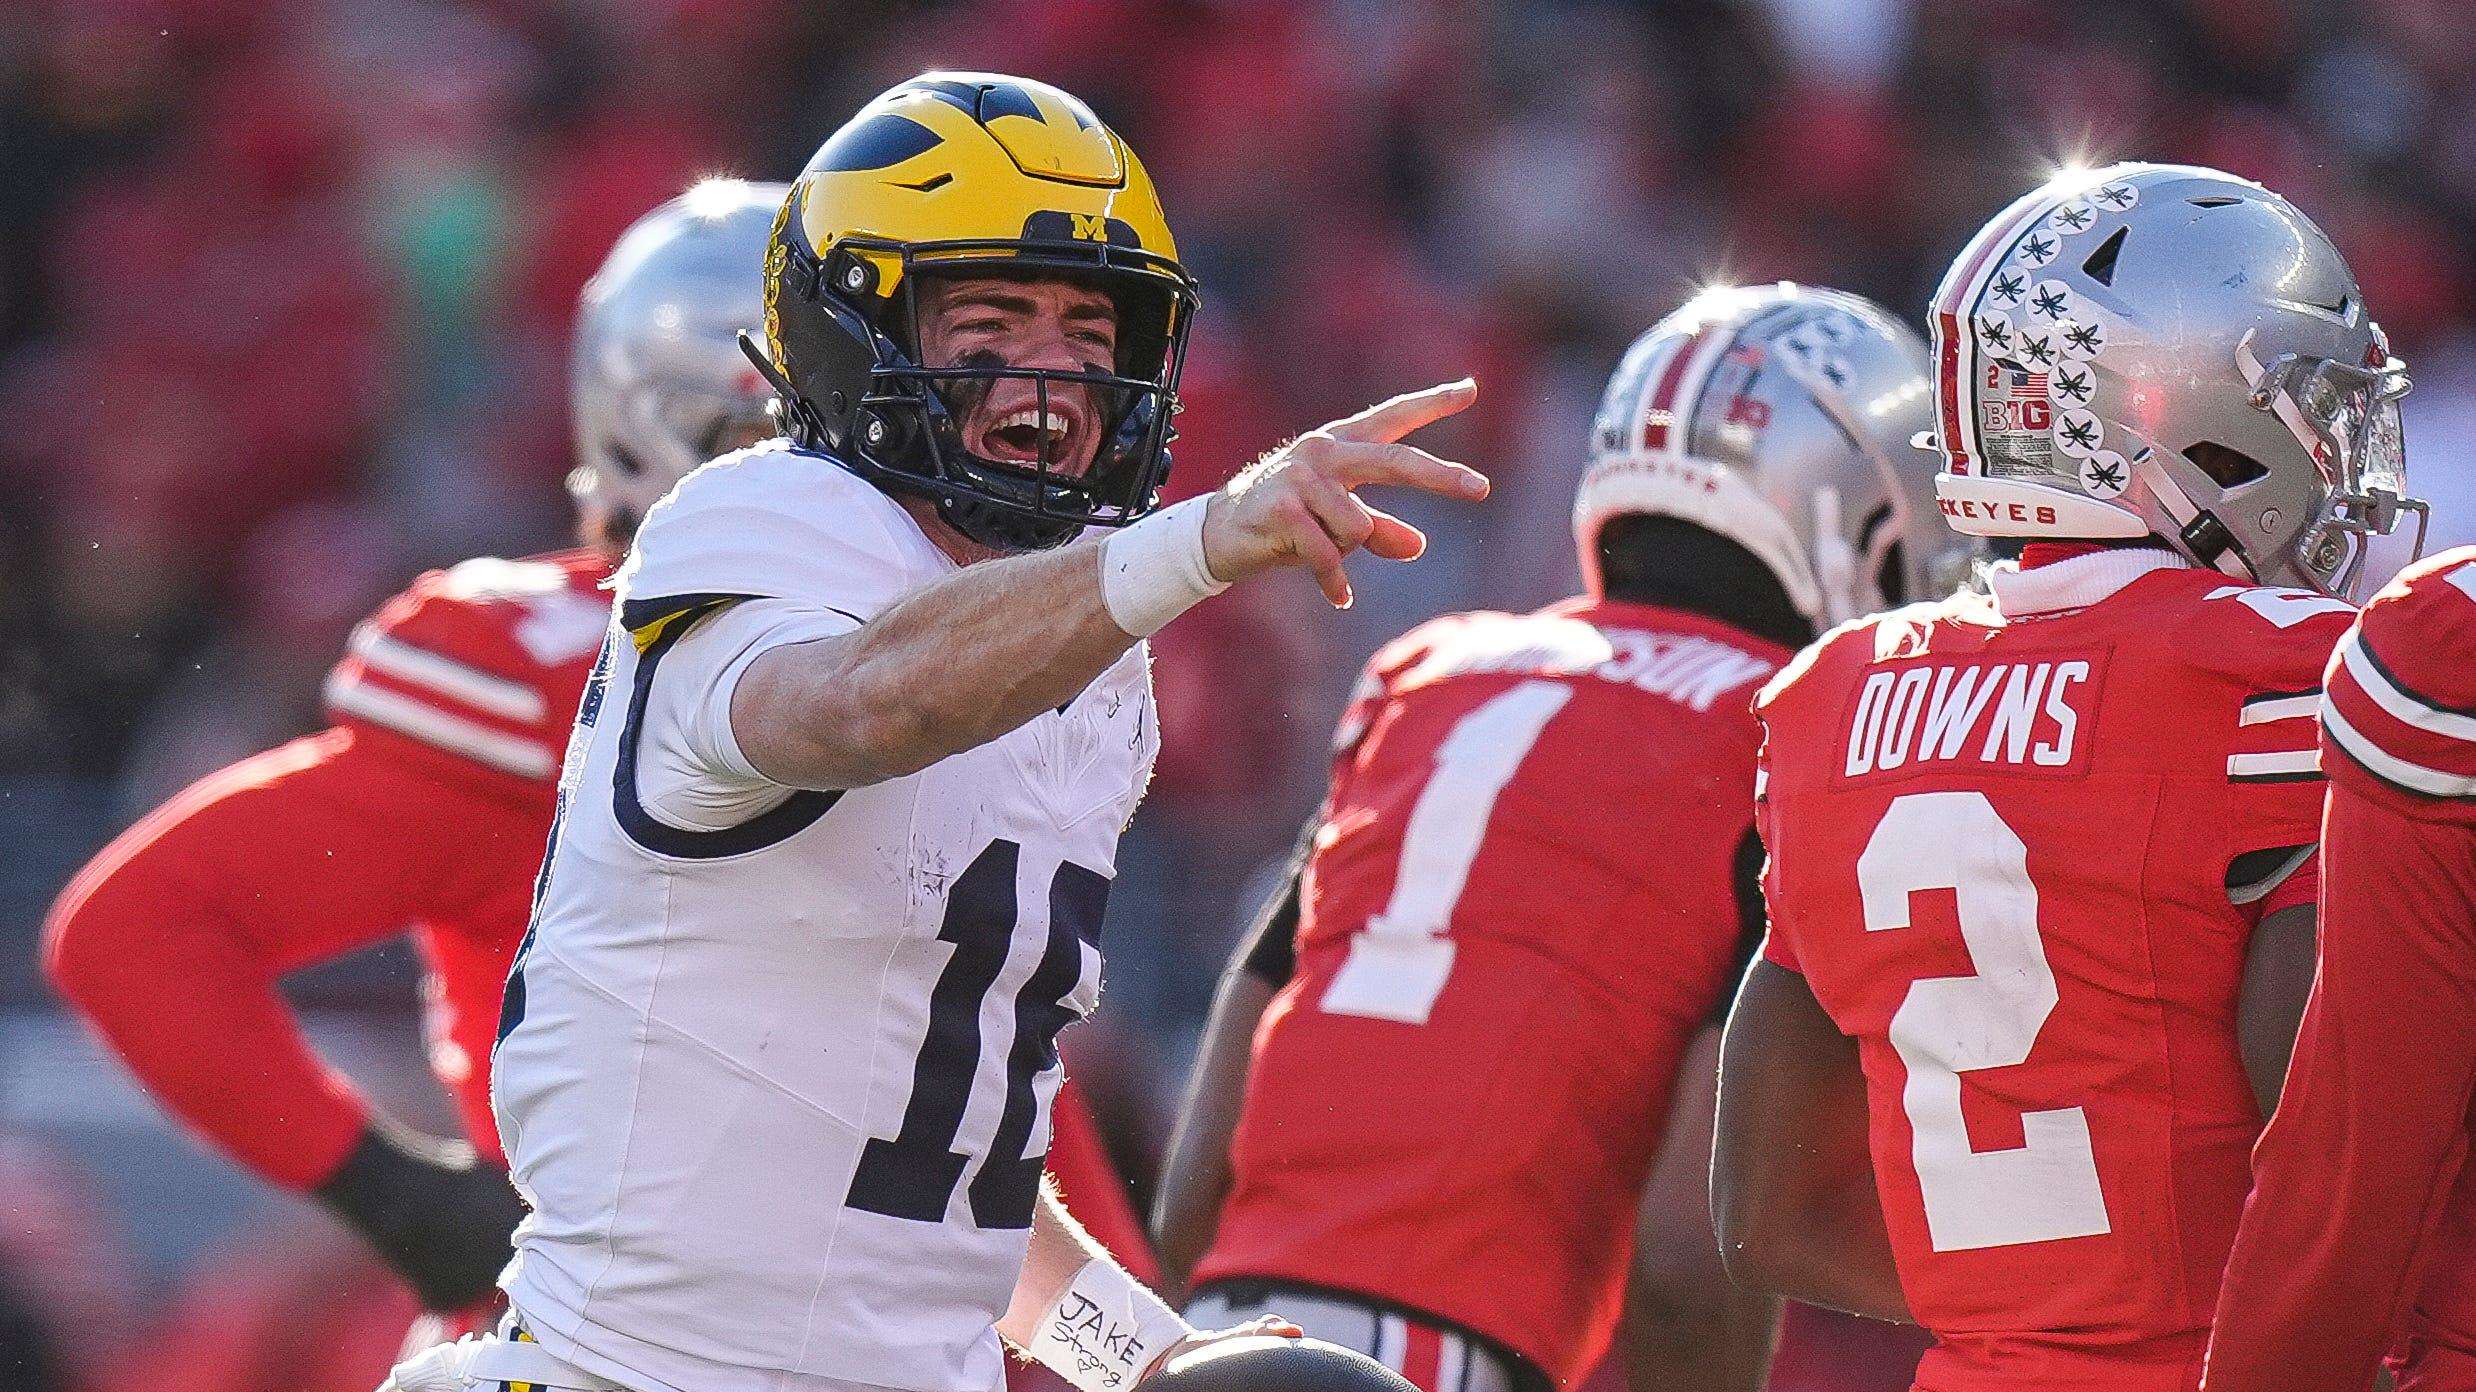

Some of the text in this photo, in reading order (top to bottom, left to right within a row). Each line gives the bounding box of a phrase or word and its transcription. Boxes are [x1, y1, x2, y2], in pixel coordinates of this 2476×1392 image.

[1071, 214, 1107, 242] M
[1987, 365, 1999, 389] 2
[1937, 499, 2056, 525] CKEYES
[1844, 660, 2090, 778] DOWNS
[1319, 680, 1574, 1027] 1
[1857, 791, 2112, 1253] 2
[1051, 1321, 1122, 1388] Strong
[1059, 1291, 1144, 1366] JAKE
